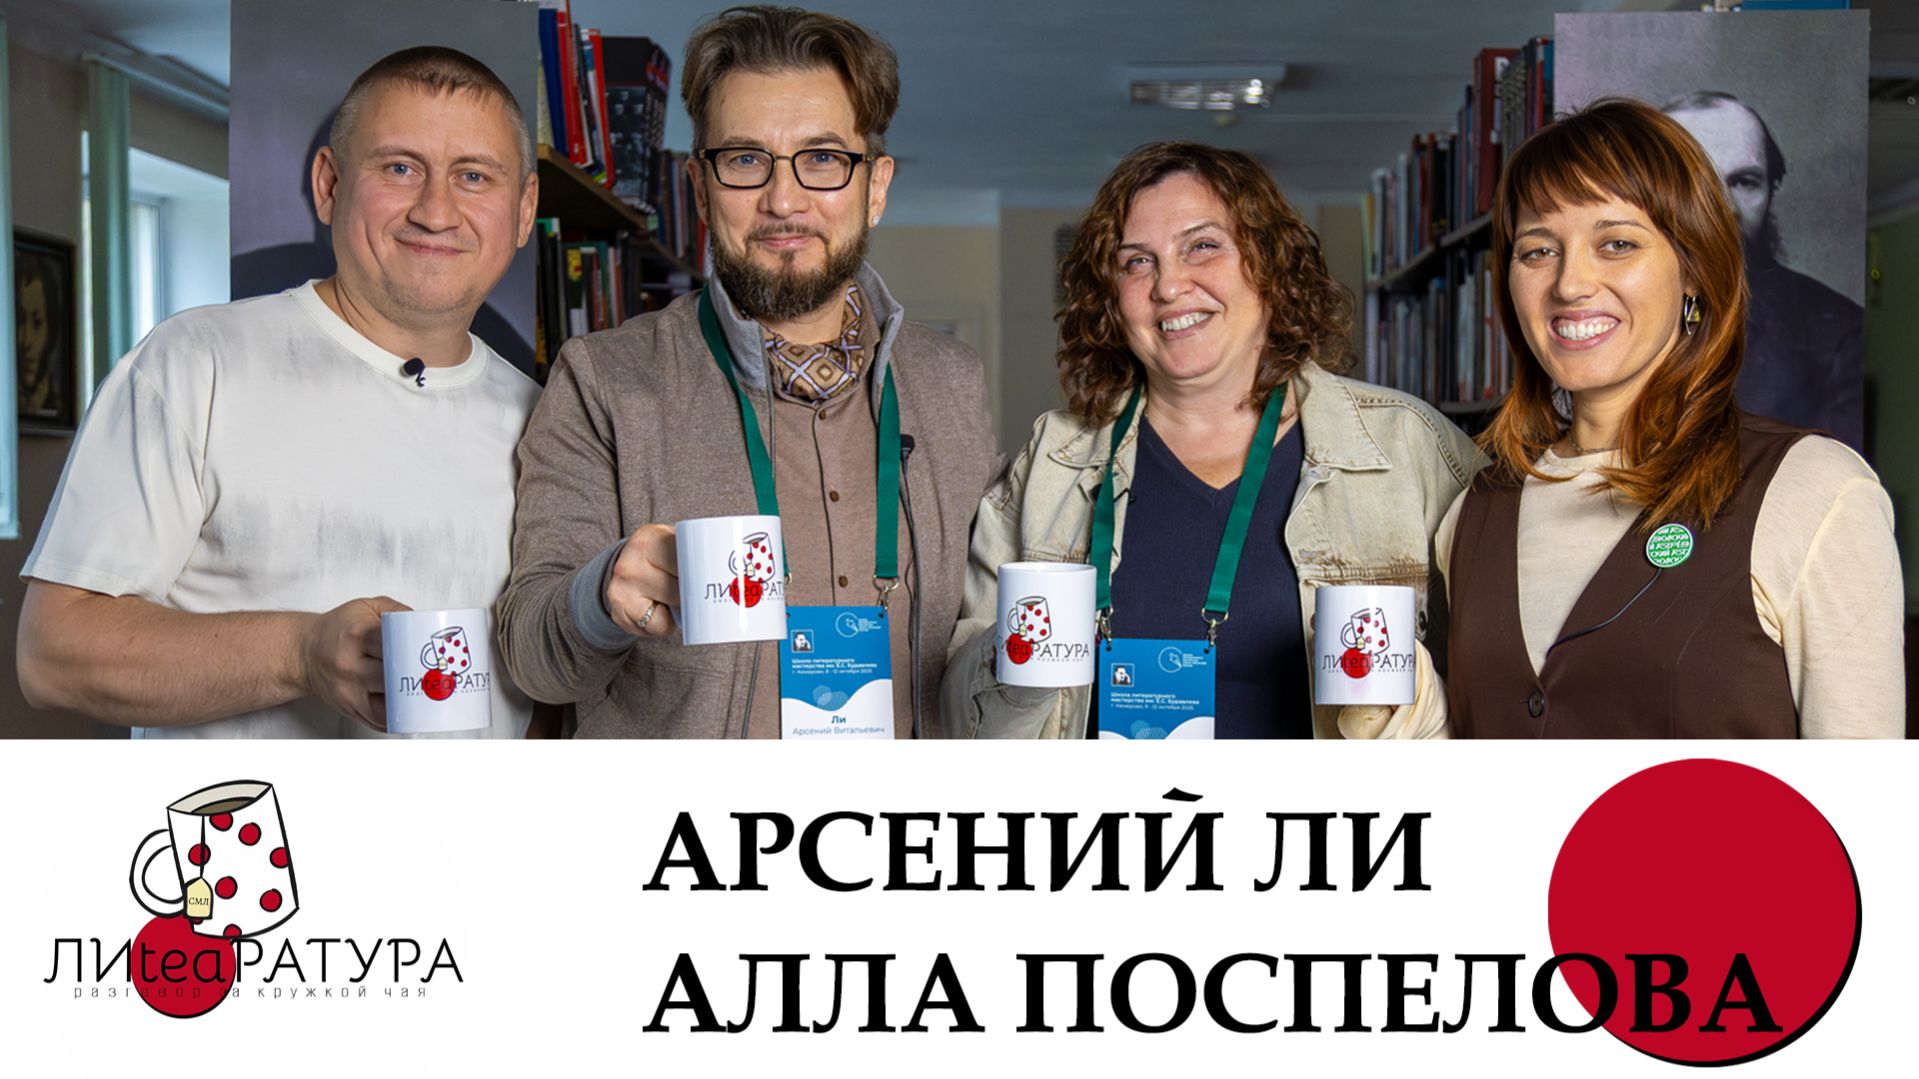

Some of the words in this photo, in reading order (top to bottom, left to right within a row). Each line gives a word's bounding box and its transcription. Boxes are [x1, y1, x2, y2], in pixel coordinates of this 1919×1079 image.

[831, 715, 847, 724] Ли
[792, 726, 832, 736] Арсений
[834, 726, 885, 735] Витальевич
